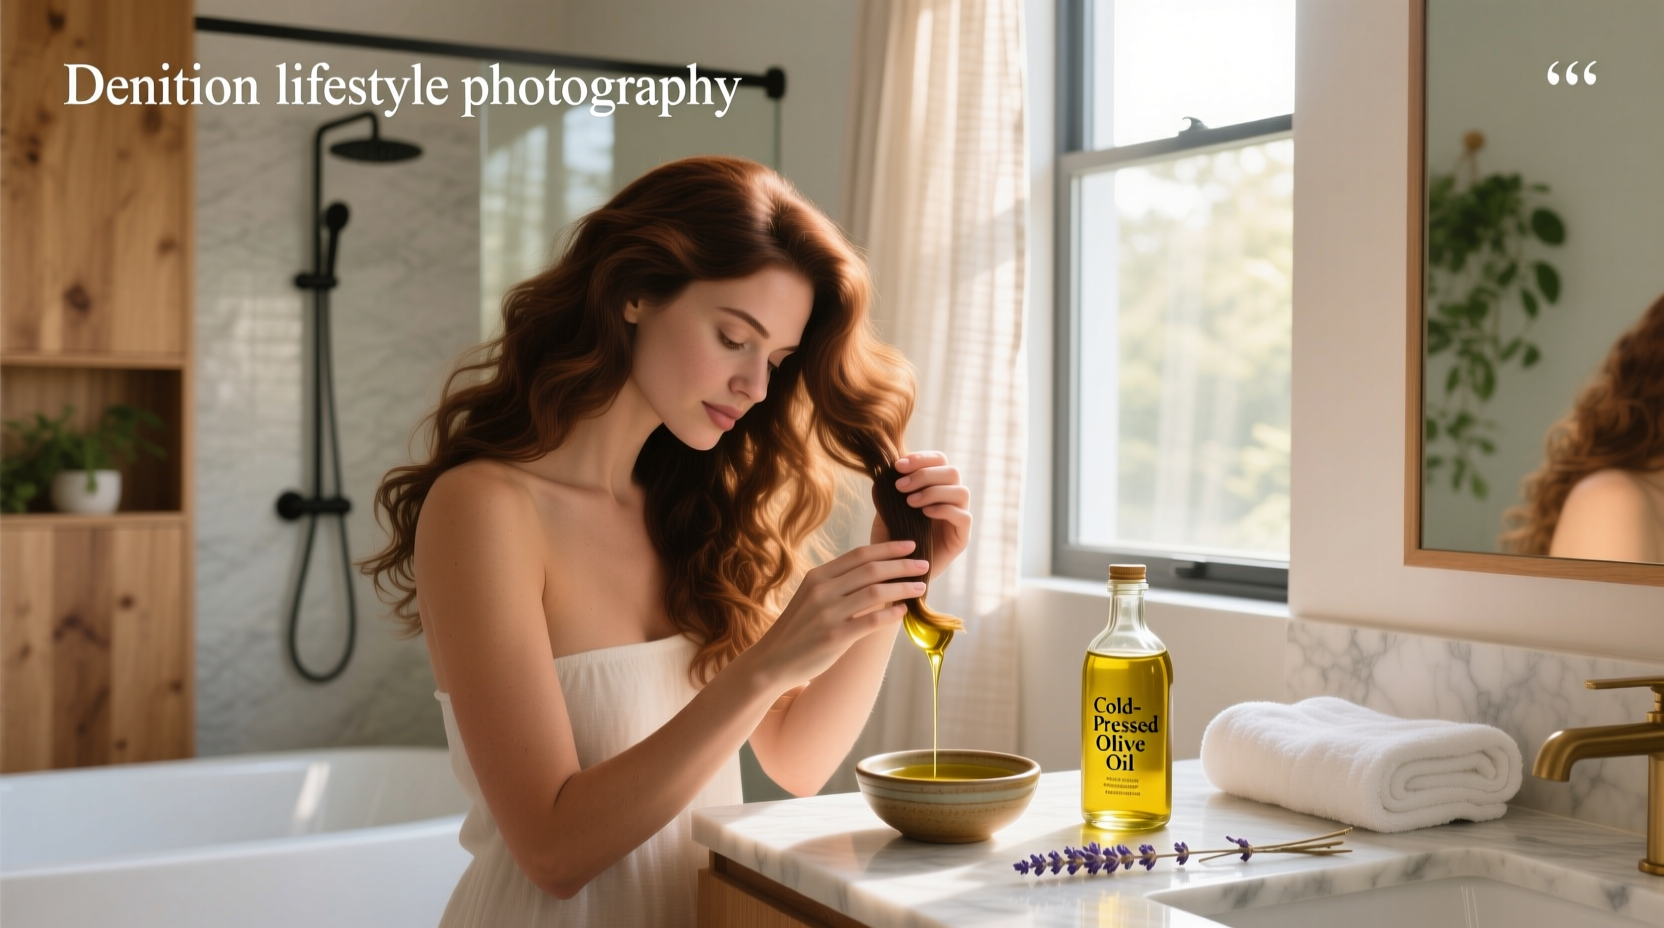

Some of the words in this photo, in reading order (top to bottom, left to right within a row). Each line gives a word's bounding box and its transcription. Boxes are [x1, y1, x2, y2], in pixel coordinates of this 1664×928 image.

[1093, 696, 1142, 714] Cold-
[1093, 715, 1159, 733] Pressed
[1096, 734, 1146, 752] Olive
[1106, 753, 1135, 771] Oil
